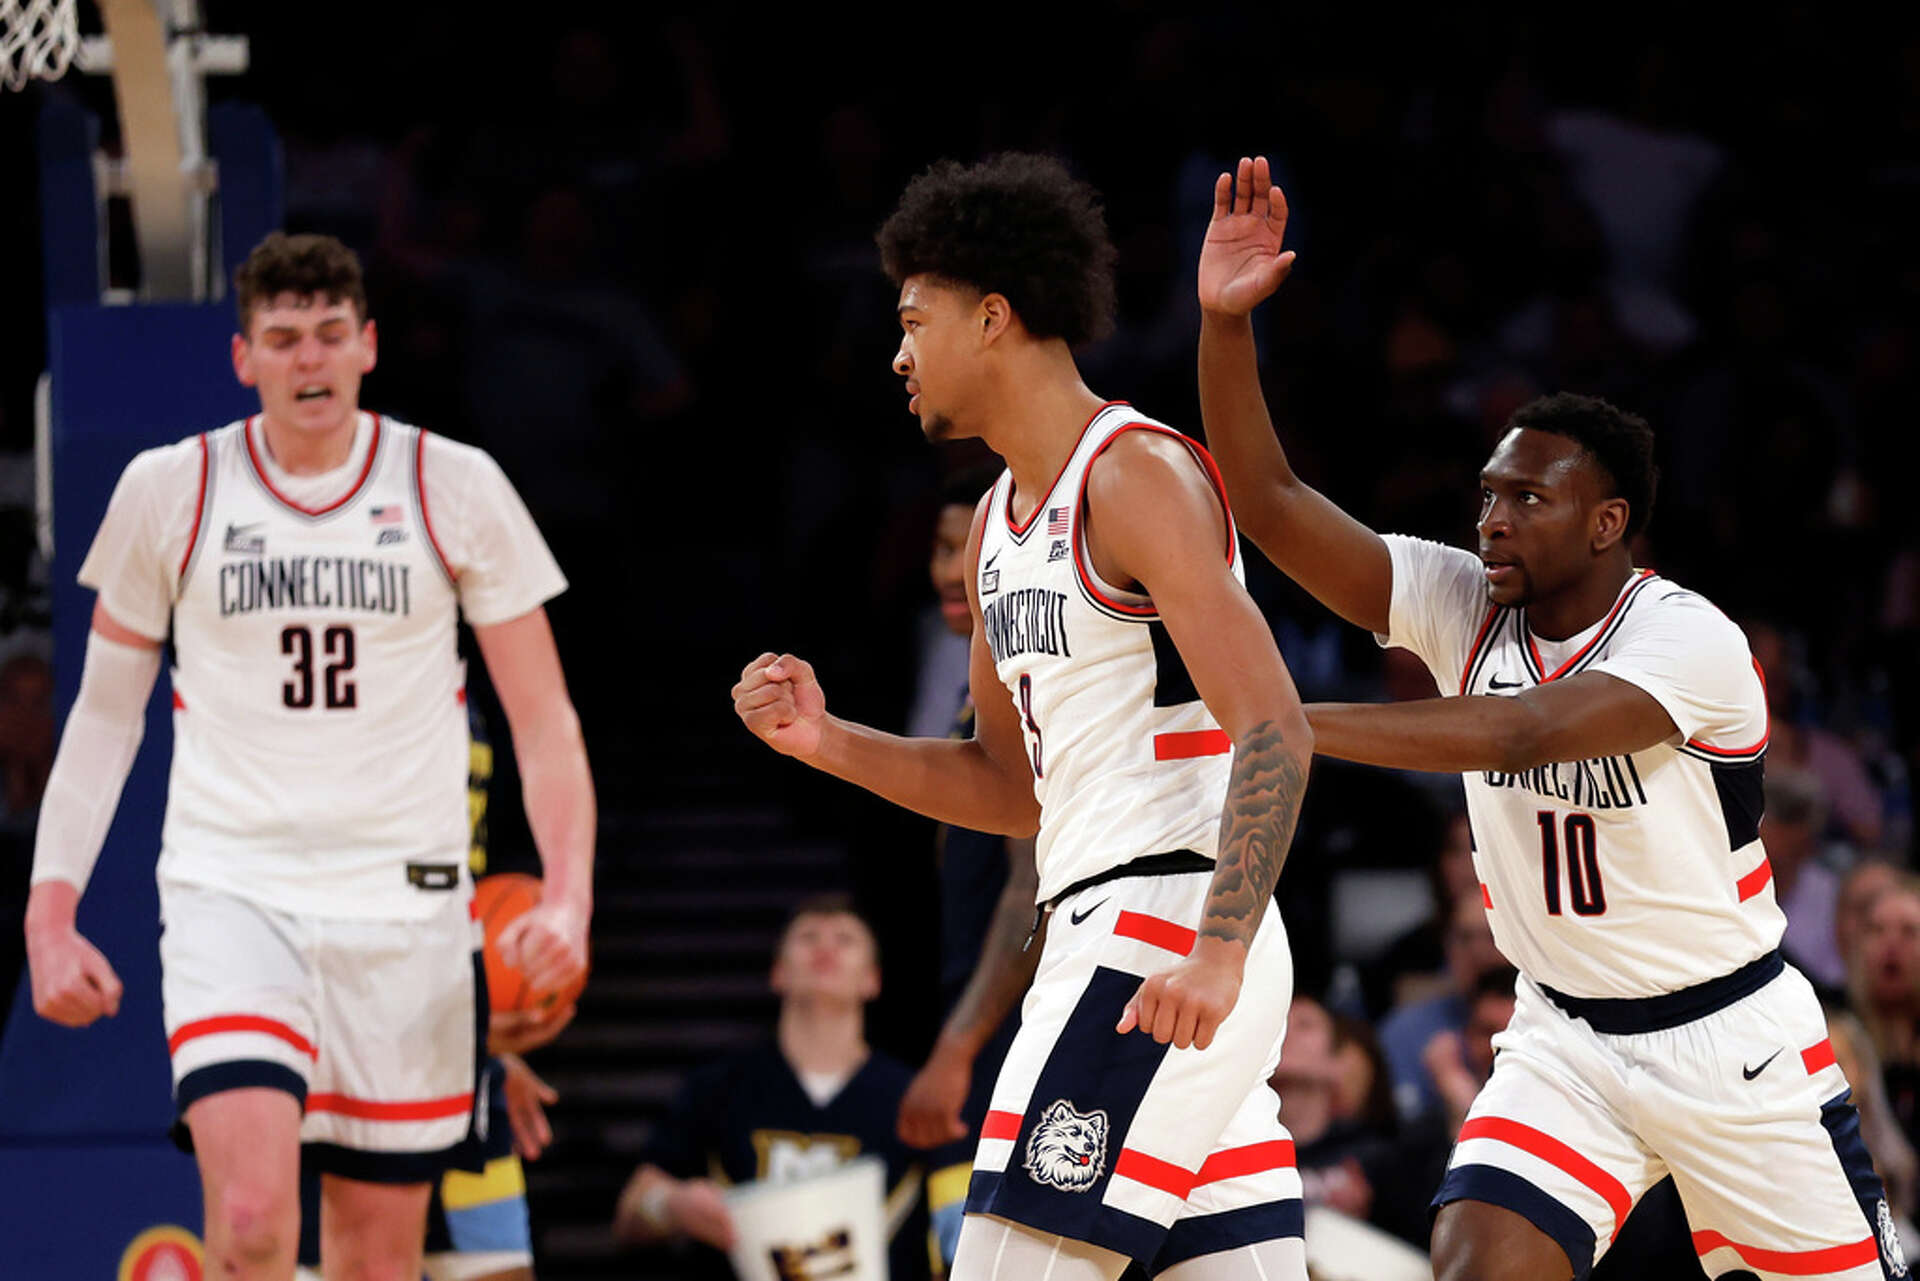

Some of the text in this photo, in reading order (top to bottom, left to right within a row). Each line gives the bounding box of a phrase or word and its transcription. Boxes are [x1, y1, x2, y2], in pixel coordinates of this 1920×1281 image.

[219, 556, 410, 617] CONNECTICUT
[281, 623, 357, 710] 32
[1537, 810, 1607, 916] 10
